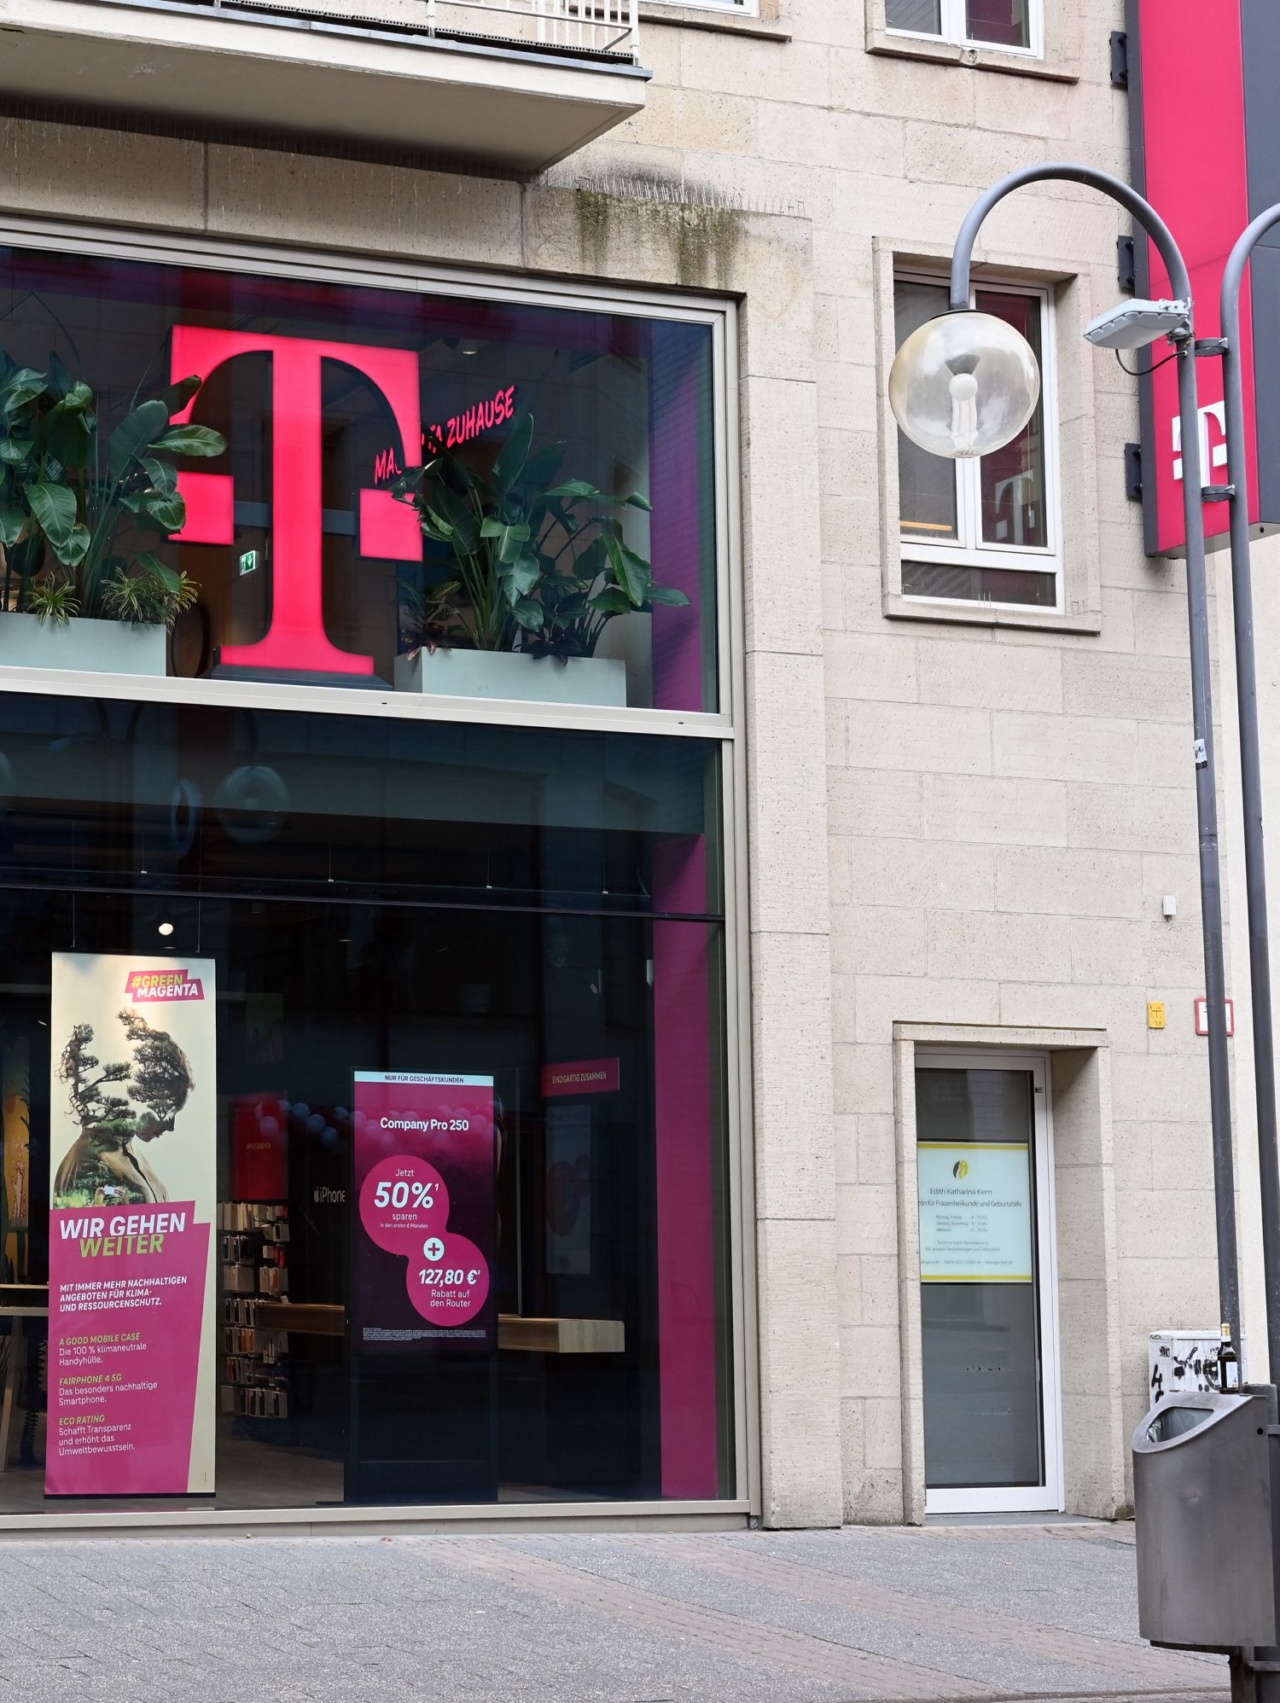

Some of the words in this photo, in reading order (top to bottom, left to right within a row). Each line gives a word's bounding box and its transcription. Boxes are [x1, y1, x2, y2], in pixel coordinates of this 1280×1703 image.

[446, 385, 515, 448] ZUHAUSE
[132, 974, 183, 988] #GREEN
[137, 983, 199, 998] MAGENTA
[397, 1074, 409, 1082] FÜR
[409, 1075, 464, 1083] GESCHÄFTSKUNDEN
[552, 1073, 580, 1084] EINZIGARTIG
[580, 1071, 607, 1082] ZUSAMMEN
[380, 1117, 429, 1132] Company
[431, 1119, 448, 1130] Pro
[449, 1120, 469, 1131] 250
[395, 1169, 415, 1177] Jetzt
[320, 1186, 345, 1203] iPhone
[929, 1187, 946, 1195] Edith
[991, 1200, 1022, 1208] Geburtshilfe
[391, 1213, 418, 1221] sparen
[60, 1218, 105, 1239] WIR
[110, 1212, 186, 1236] GEHEN
[79, 1234, 164, 1258] WEITER
[60, 1283, 75, 1292] MIT
[75, 1281, 102, 1291] IMMER
[103, 1280, 127, 1289] MEHR
[128, 1276, 188, 1288] NACHHALTIGEN
[419, 1269, 464, 1287] 127,80
[60, 1291, 107, 1302] ANGEBOTEN
[109, 1289, 124, 1299] FÜR
[126, 1288, 152, 1298] KLIMA-
[431, 1289, 456, 1298] Rabatt
[458, 1289, 470, 1298] auf
[60, 1303, 76, 1312] UND
[78, 1297, 162, 1311] RESSOURCENSCHUTZ.
[430, 1299, 444, 1307] den
[446, 1299, 471, 1307] Router
[59, 1338, 65, 1346] A
[65, 1337, 89, 1346] GOOD
[90, 1334, 120, 1344] MOBILE
[121, 1332, 141, 1342] CASE
[59, 1348, 71, 1356] Die
[73, 1346, 87, 1355] 100
[88, 1345, 96, 1354] %
[97, 1342, 147, 1353] klimaneutrale
[59, 1356, 103, 1366] Handyhülle.
[59, 1375, 103, 1385] FAIRPHONE
[104, 1374, 110, 1382] 4
[111, 1374, 122, 1382] 5G
[59, 1388, 73, 1396] Das
[74, 1385, 114, 1395] besonders
[115, 1381, 158, 1391] nachhaltige
[58, 1396, 107, 1406] Smartphone.
[59, 1417, 75, 1426] ECO
[76, 1414, 105, 1424] RATING
[58, 1427, 86, 1436] Schafft
[87, 1424, 132, 1433] Transparenz
[58, 1437, 73, 1446] und
[75, 1435, 99, 1444] erhöht
[100, 1434, 115, 1443] das
[58, 1442, 135, 1456] Umweltbewusstsein.
